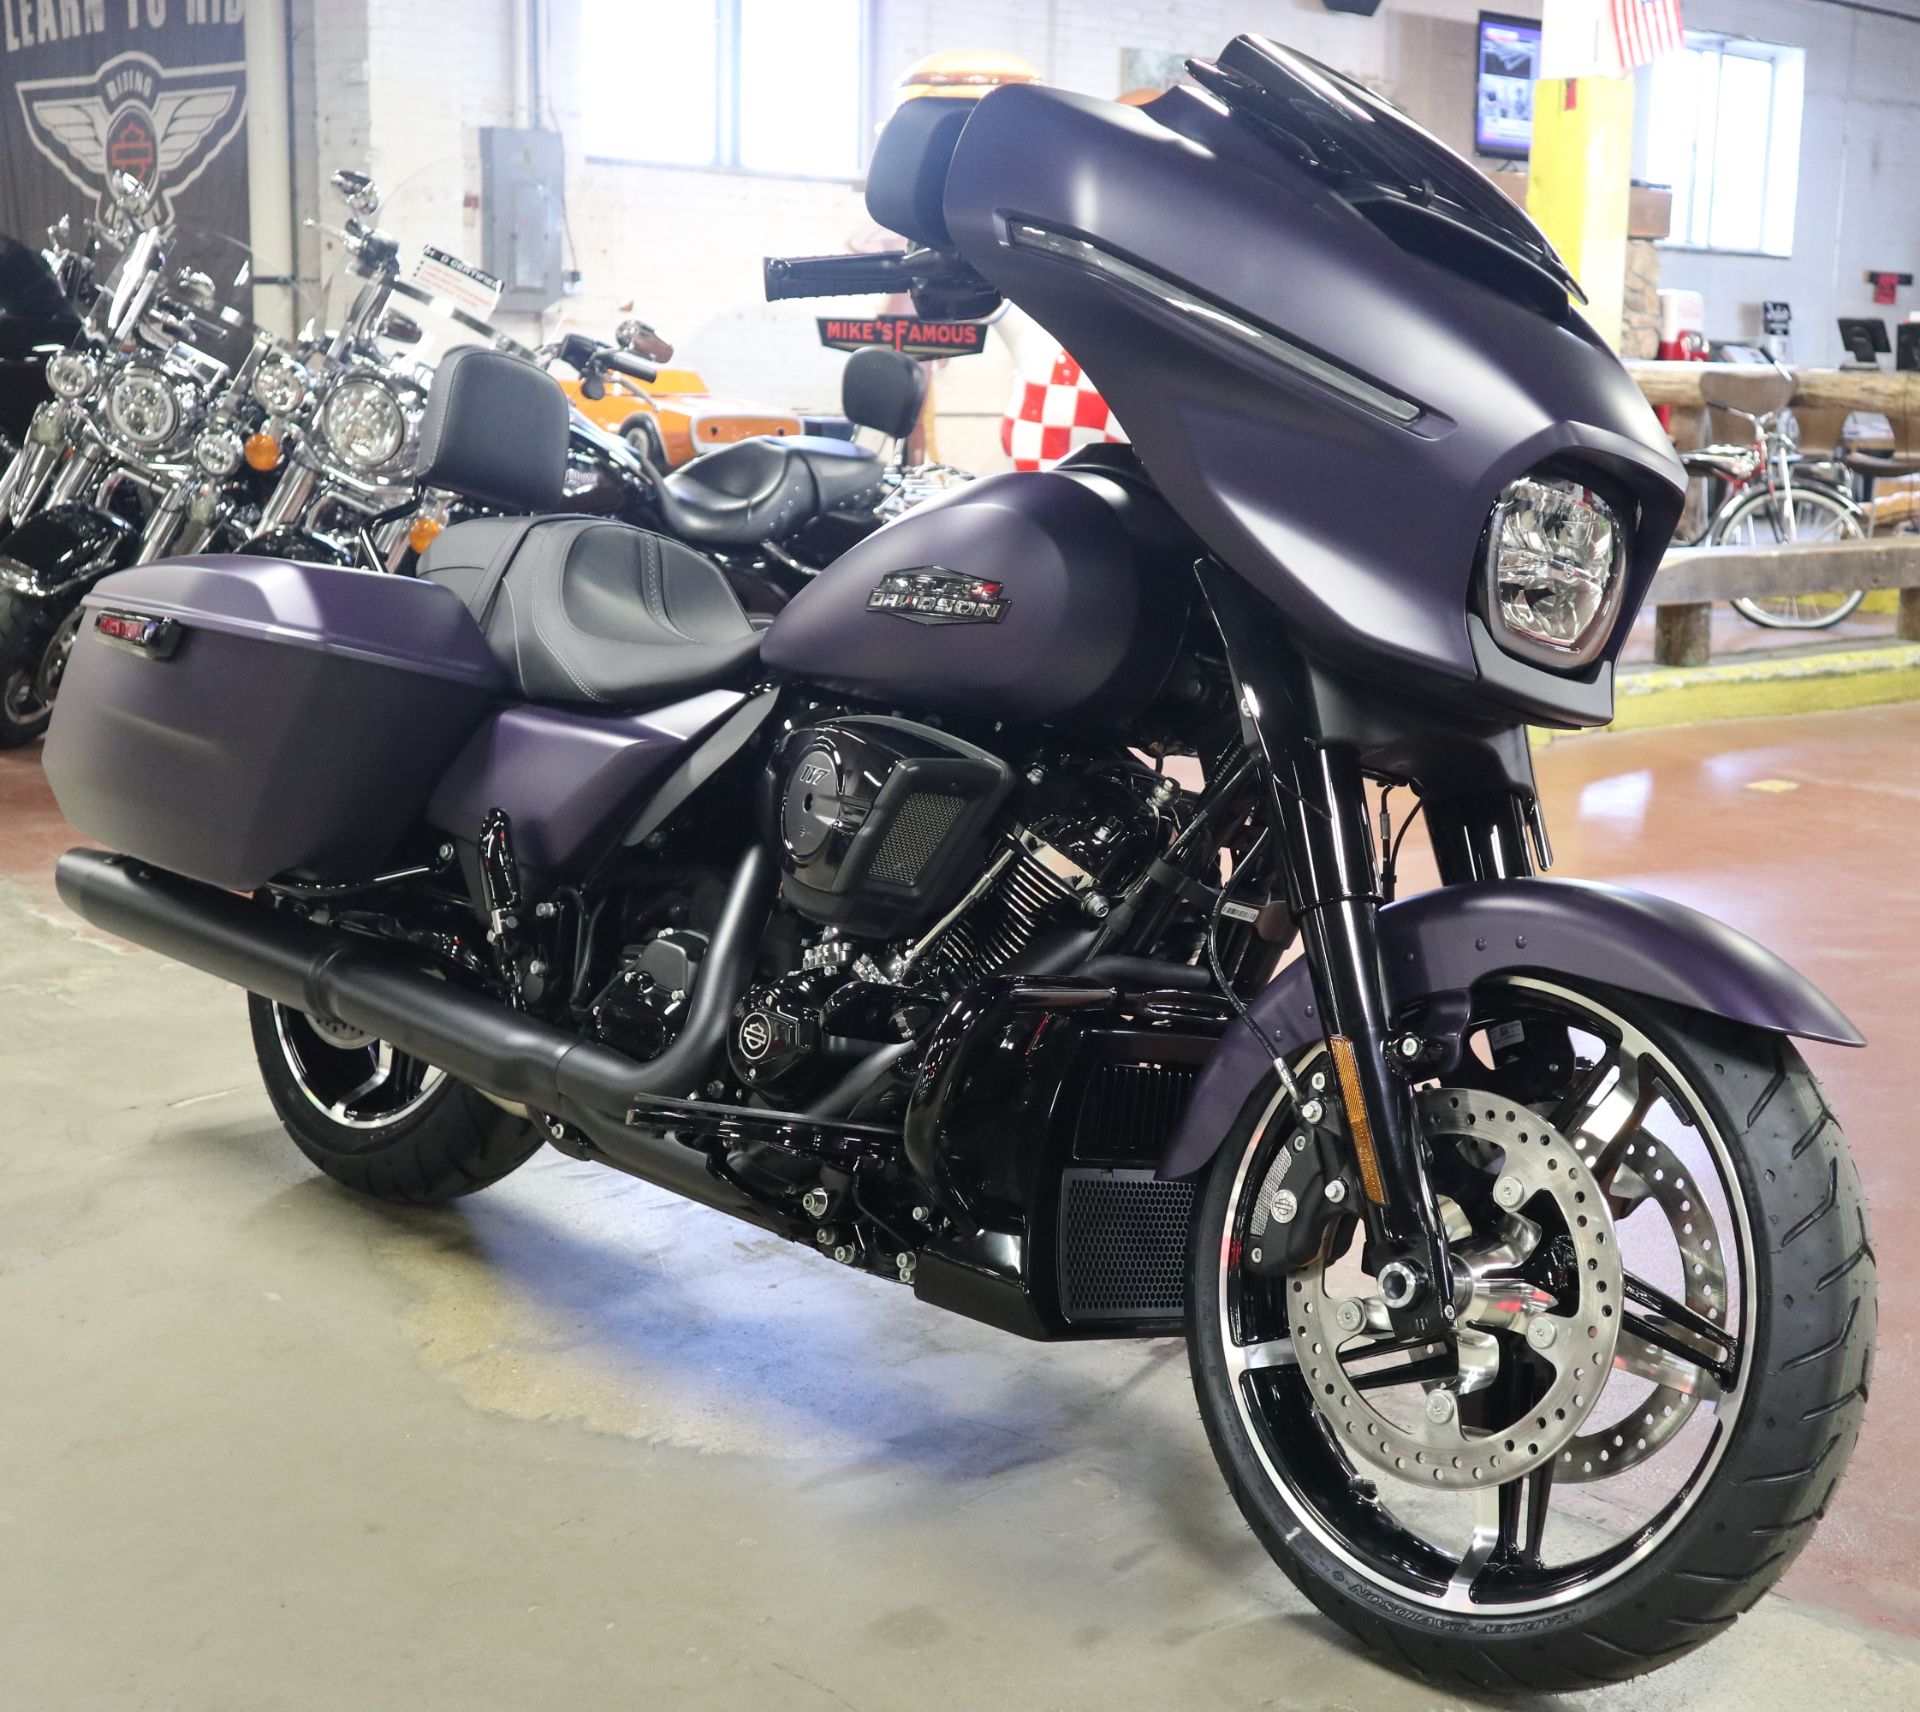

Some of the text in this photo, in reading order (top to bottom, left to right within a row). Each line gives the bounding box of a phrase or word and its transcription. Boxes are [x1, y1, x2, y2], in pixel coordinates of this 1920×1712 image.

[4, 0, 106, 52] LEARN
[826, 319, 978, 352] MIKE'S FAMOUS
[868, 592, 1001, 618] DAVIDSON
[800, 764, 832, 786] 117
